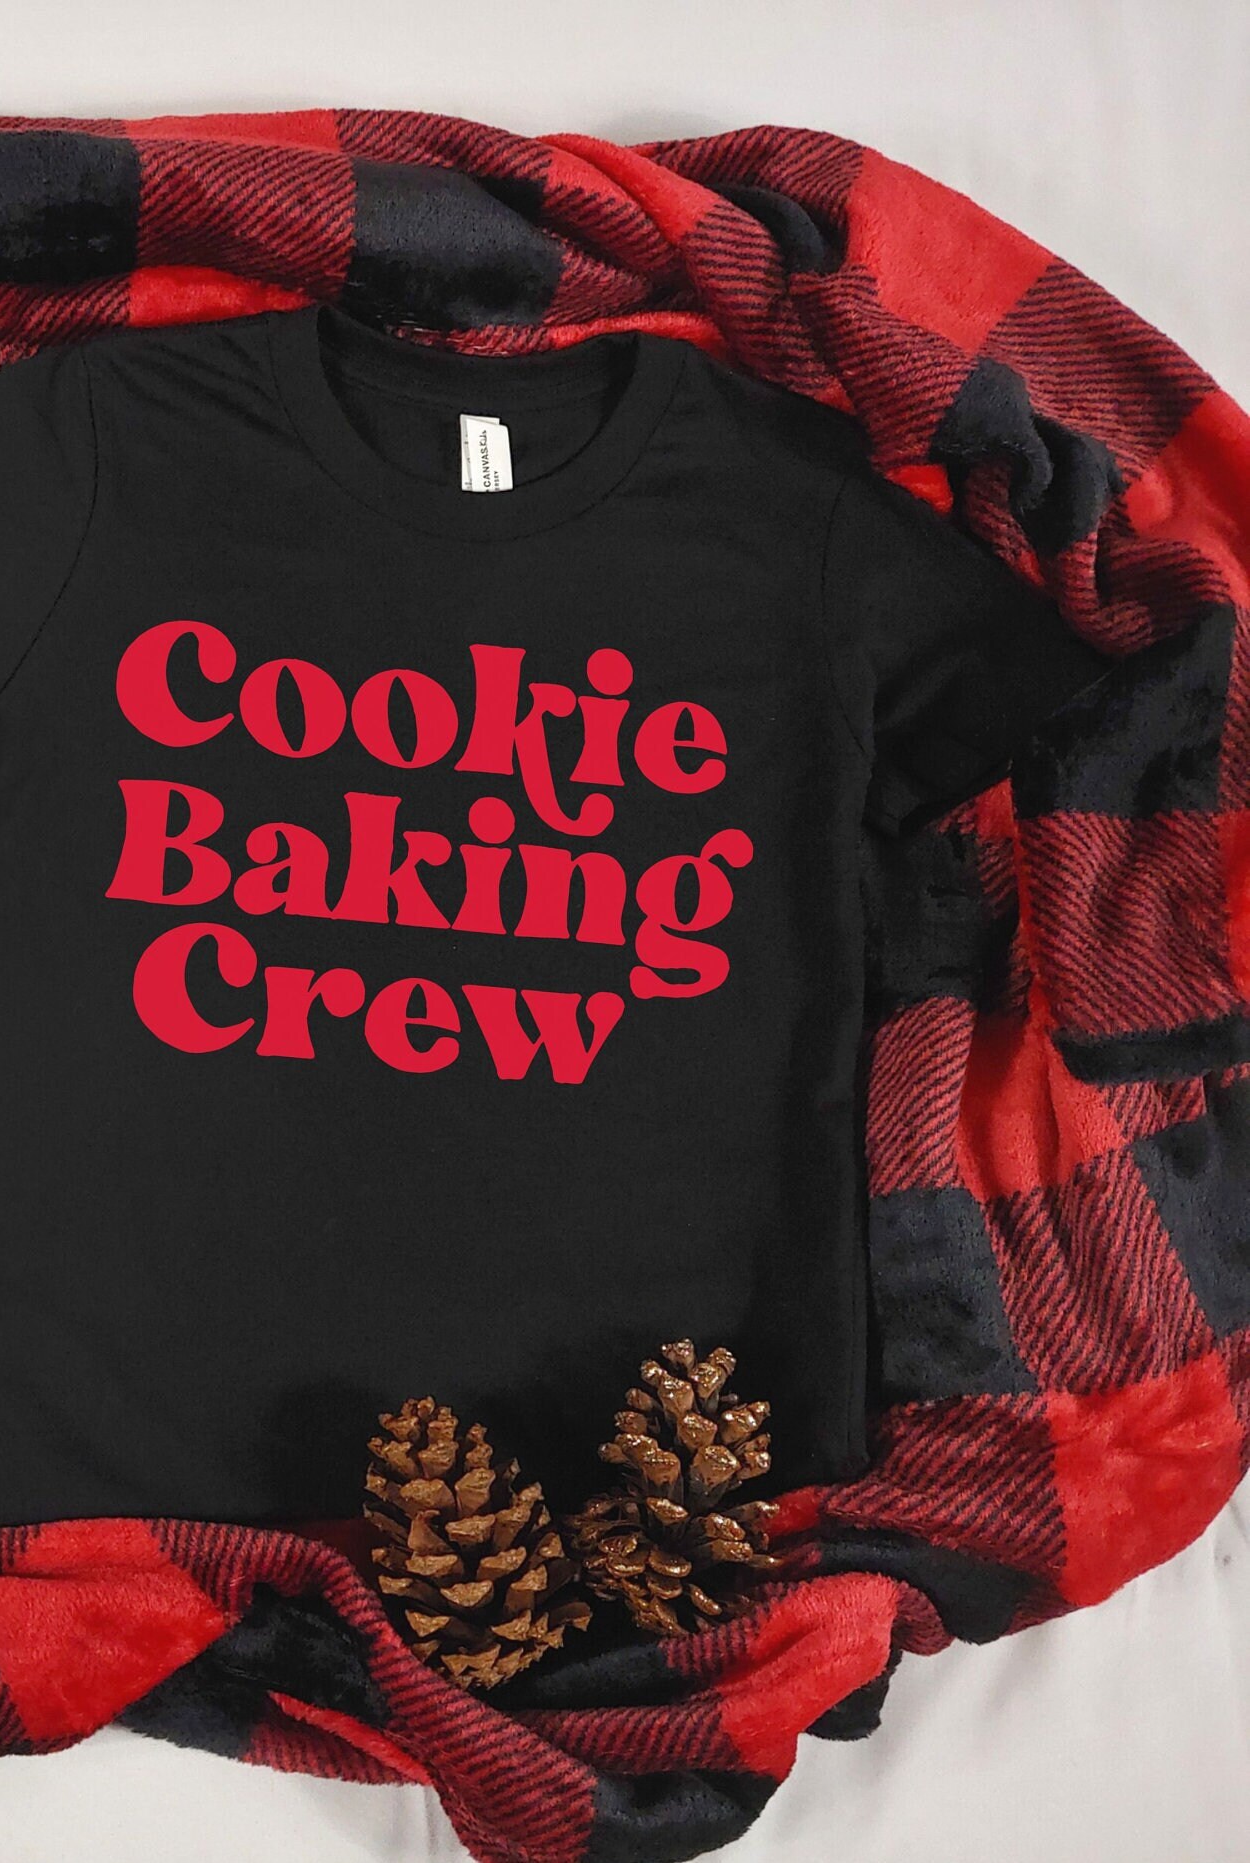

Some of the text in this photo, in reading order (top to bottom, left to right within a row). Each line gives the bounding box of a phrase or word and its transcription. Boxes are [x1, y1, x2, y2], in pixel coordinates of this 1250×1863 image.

[480, 448, 491, 488] CANVAS
[116, 621, 727, 836] Cookie
[105, 780, 753, 999] Baking
[133, 923, 625, 1084] Crew
